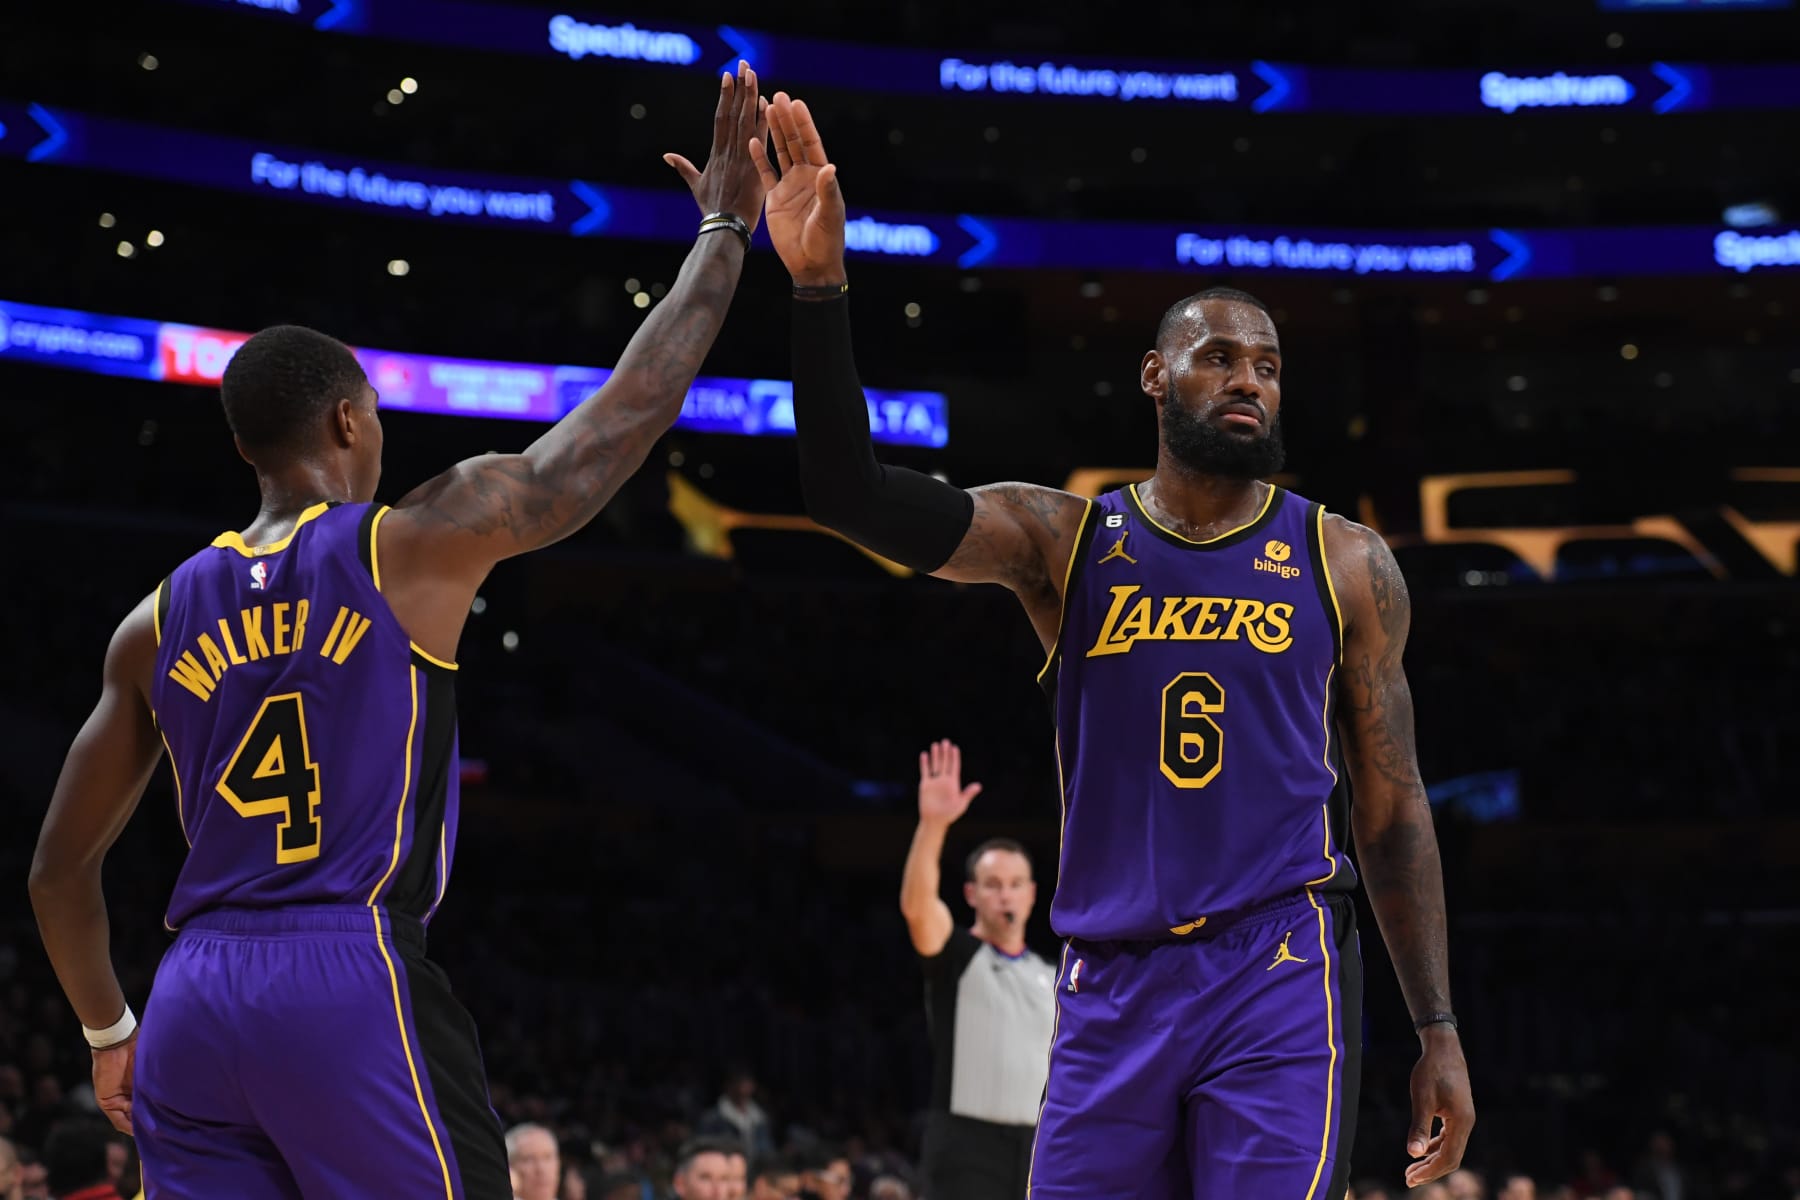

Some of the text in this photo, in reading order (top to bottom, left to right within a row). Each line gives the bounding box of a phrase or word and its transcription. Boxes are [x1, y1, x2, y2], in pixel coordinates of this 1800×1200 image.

[549, 14, 695, 65] Spectrum
[940, 58, 1237, 101] For the future you want
[1480, 71, 1628, 114] Spectrum
[251, 153, 555, 222] For the future you want
[1176, 233, 1474, 274] For the future you want
[11, 320, 145, 362] crypto.com
[1106, 514, 1124, 528] 6
[1253, 557, 1301, 579] bibigo
[1086, 584, 1295, 658] LAKERS
[168, 598, 372, 703] WALKER IV
[1159, 671, 1226, 789] 6
[215, 691, 322, 865] 4
